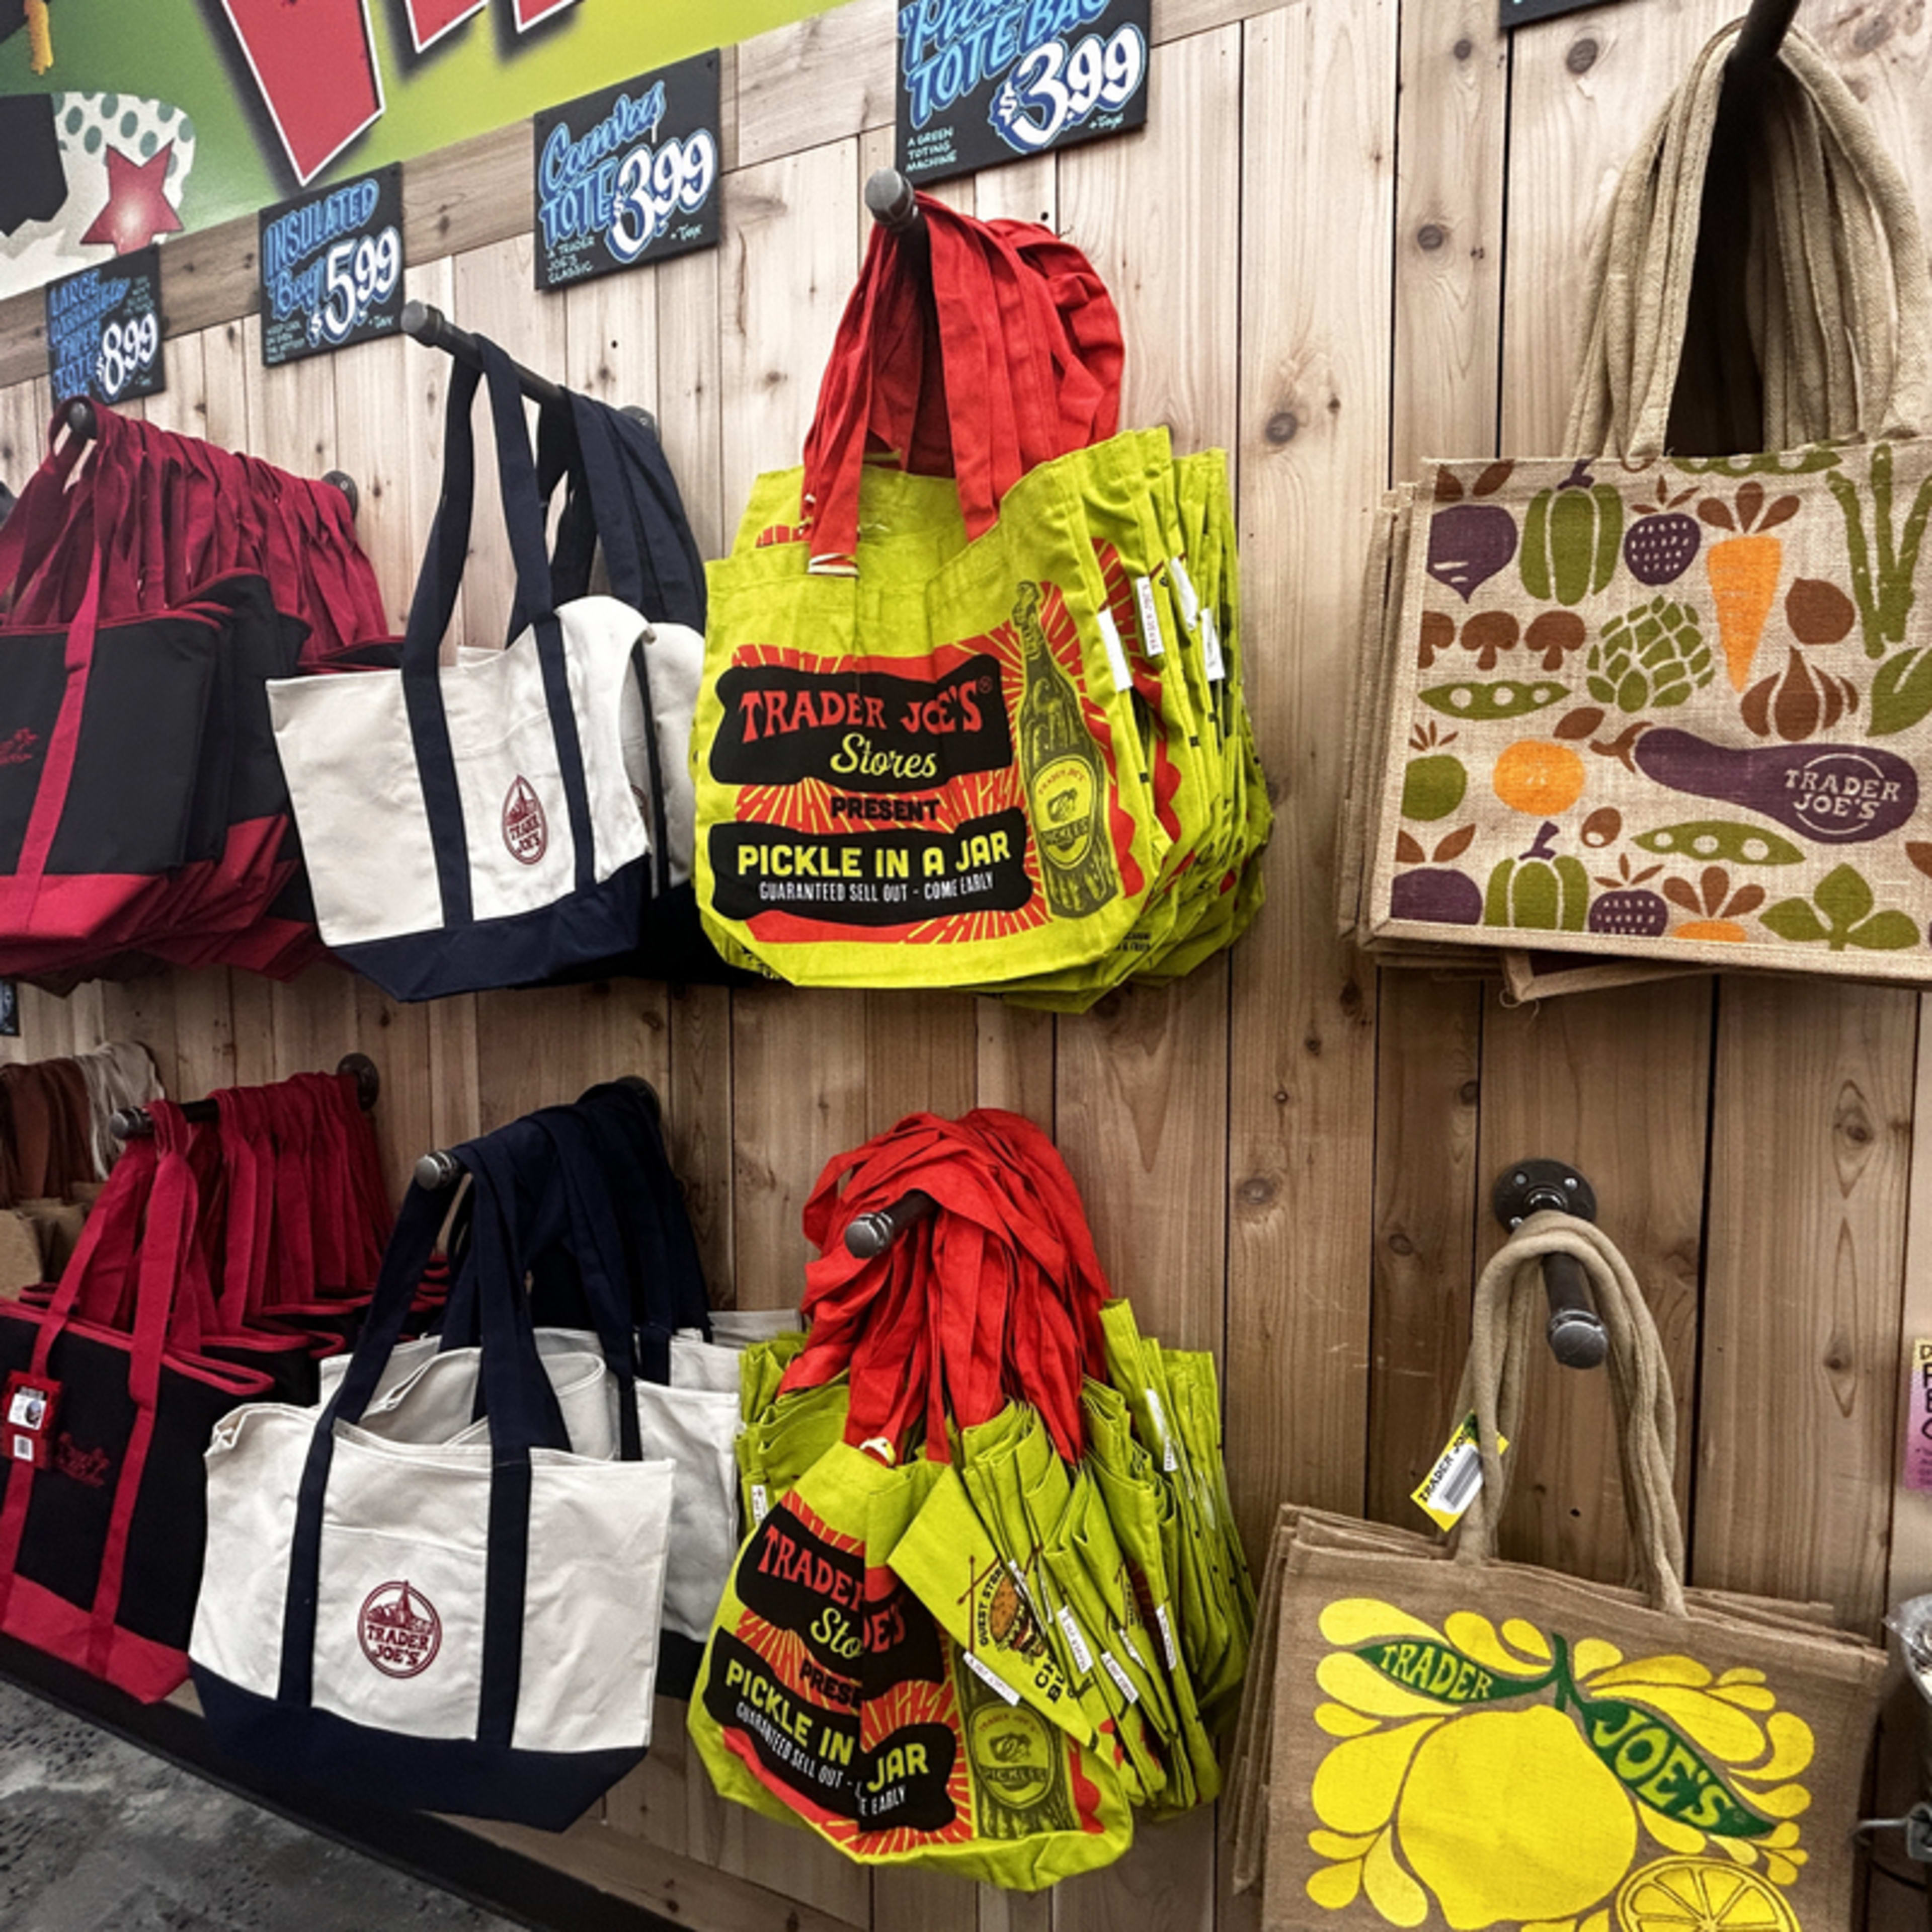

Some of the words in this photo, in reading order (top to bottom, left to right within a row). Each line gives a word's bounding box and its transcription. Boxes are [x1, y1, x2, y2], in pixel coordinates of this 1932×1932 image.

[906, 7, 1023, 128] TOTE
[907, 137, 915, 147] A
[917, 126, 954, 145] GREEN
[908, 140, 950, 160] TOTING
[906, 149, 956, 172] MACHINE
[540, 157, 619, 249] TOTE
[265, 179, 379, 285] INSULATED
[739, 690, 887, 743] TRADER
[831, 733, 937, 778] Stores
[1785, 768, 1901, 801] TRADER
[831, 795, 941, 821] PRESENT
[1794, 793, 1880, 820] JOE'S
[738, 845, 862, 877] PICKLE
[875, 849, 909, 877] IN
[924, 847, 944, 877] A
[956, 831, 1011, 871] JAR
[760, 881, 846, 901] GUARANTEED
[850, 883, 878, 902] SELL
[883, 883, 908, 902] OUT
[924, 879, 956, 900] COME
[960, 872, 993, 895] EARLY
[367, 1625, 429, 1652] TRADER
[375, 1645, 421, 1666] JOE'S
[1380, 1643, 1494, 1701] TRADER
[726, 1659, 813, 1746] PICKLE
[819, 1727, 854, 1766] IN
[866, 1743, 929, 1792] JAR
[736, 1702, 794, 1761] GUARANTEED
[793, 1747, 815, 1777] SELL
[818, 1765, 843, 1788] OUT
